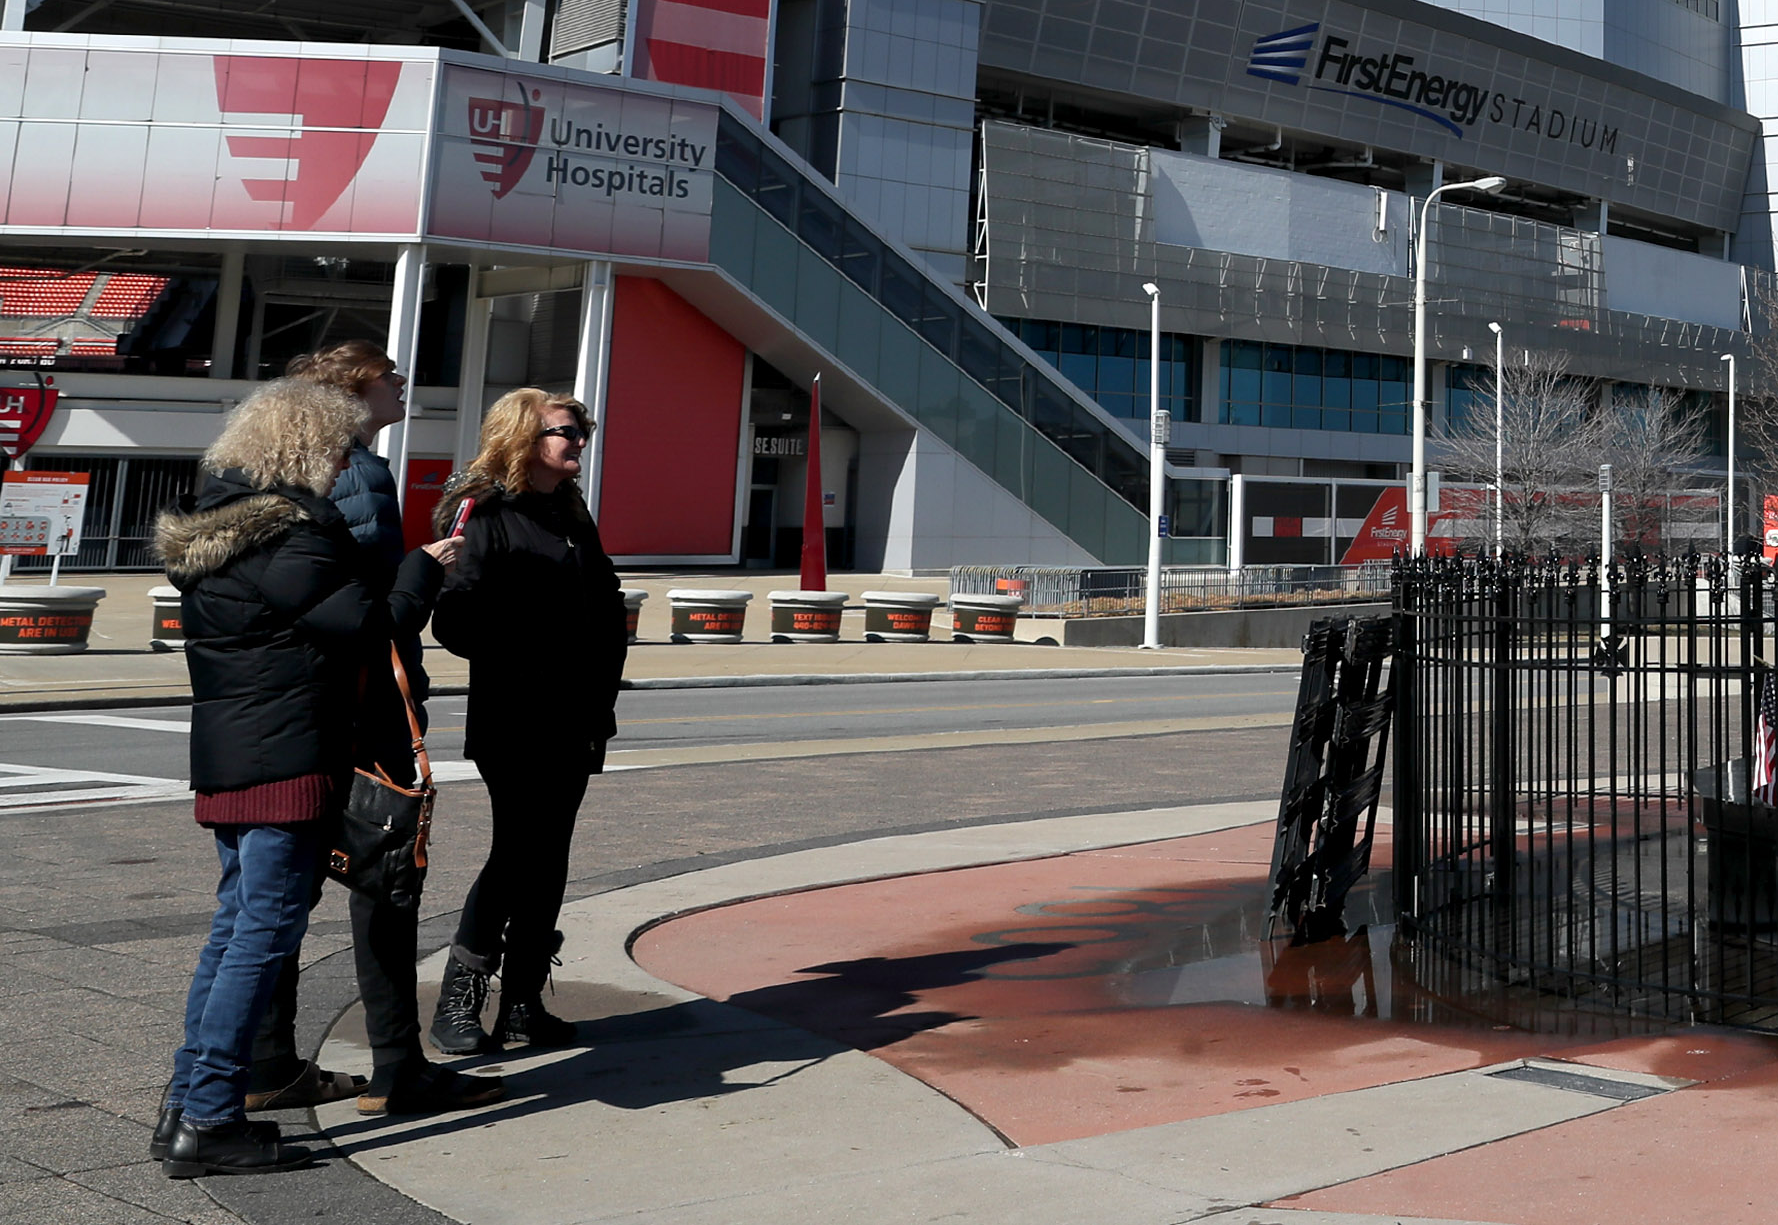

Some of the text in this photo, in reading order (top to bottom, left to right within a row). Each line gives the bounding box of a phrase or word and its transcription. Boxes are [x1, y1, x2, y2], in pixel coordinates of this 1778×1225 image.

[1315, 36, 1620, 155] FirstEnergy STADIUM
[474, 109, 508, 136] UH
[550, 118, 707, 172] University
[546, 156, 690, 199] Hospitals
[1371, 527, 1407, 539] FirstEnergy
[0, 616, 35, 627] METAL
[689, 613, 716, 621] METAL
[18, 627, 43, 638] ARE
[44, 627, 57, 638] IN
